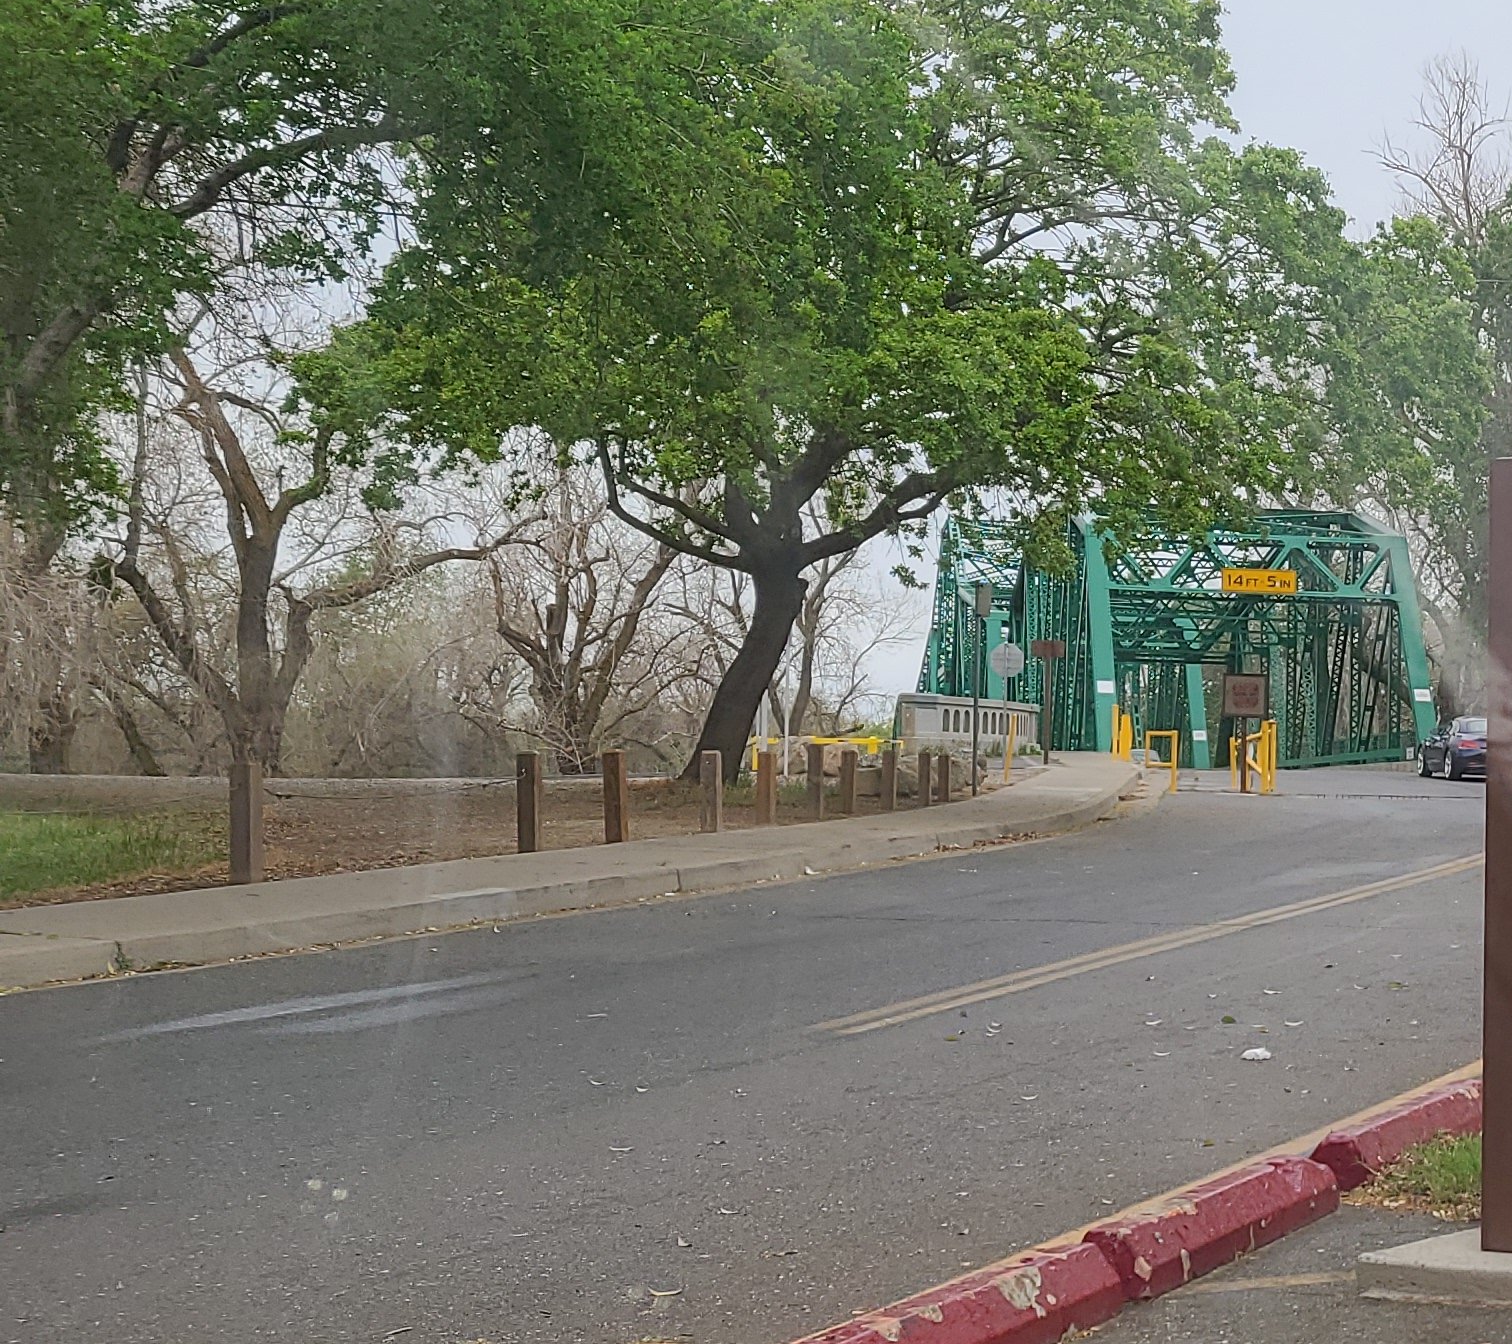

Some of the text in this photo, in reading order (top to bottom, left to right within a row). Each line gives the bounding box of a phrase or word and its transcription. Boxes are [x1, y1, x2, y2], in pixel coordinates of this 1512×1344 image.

[1227, 574, 1243, 587] 14
[1246, 578, 1259, 587] FT
[1267, 575, 1277, 588] 5
[1280, 579, 1291, 588] IN
